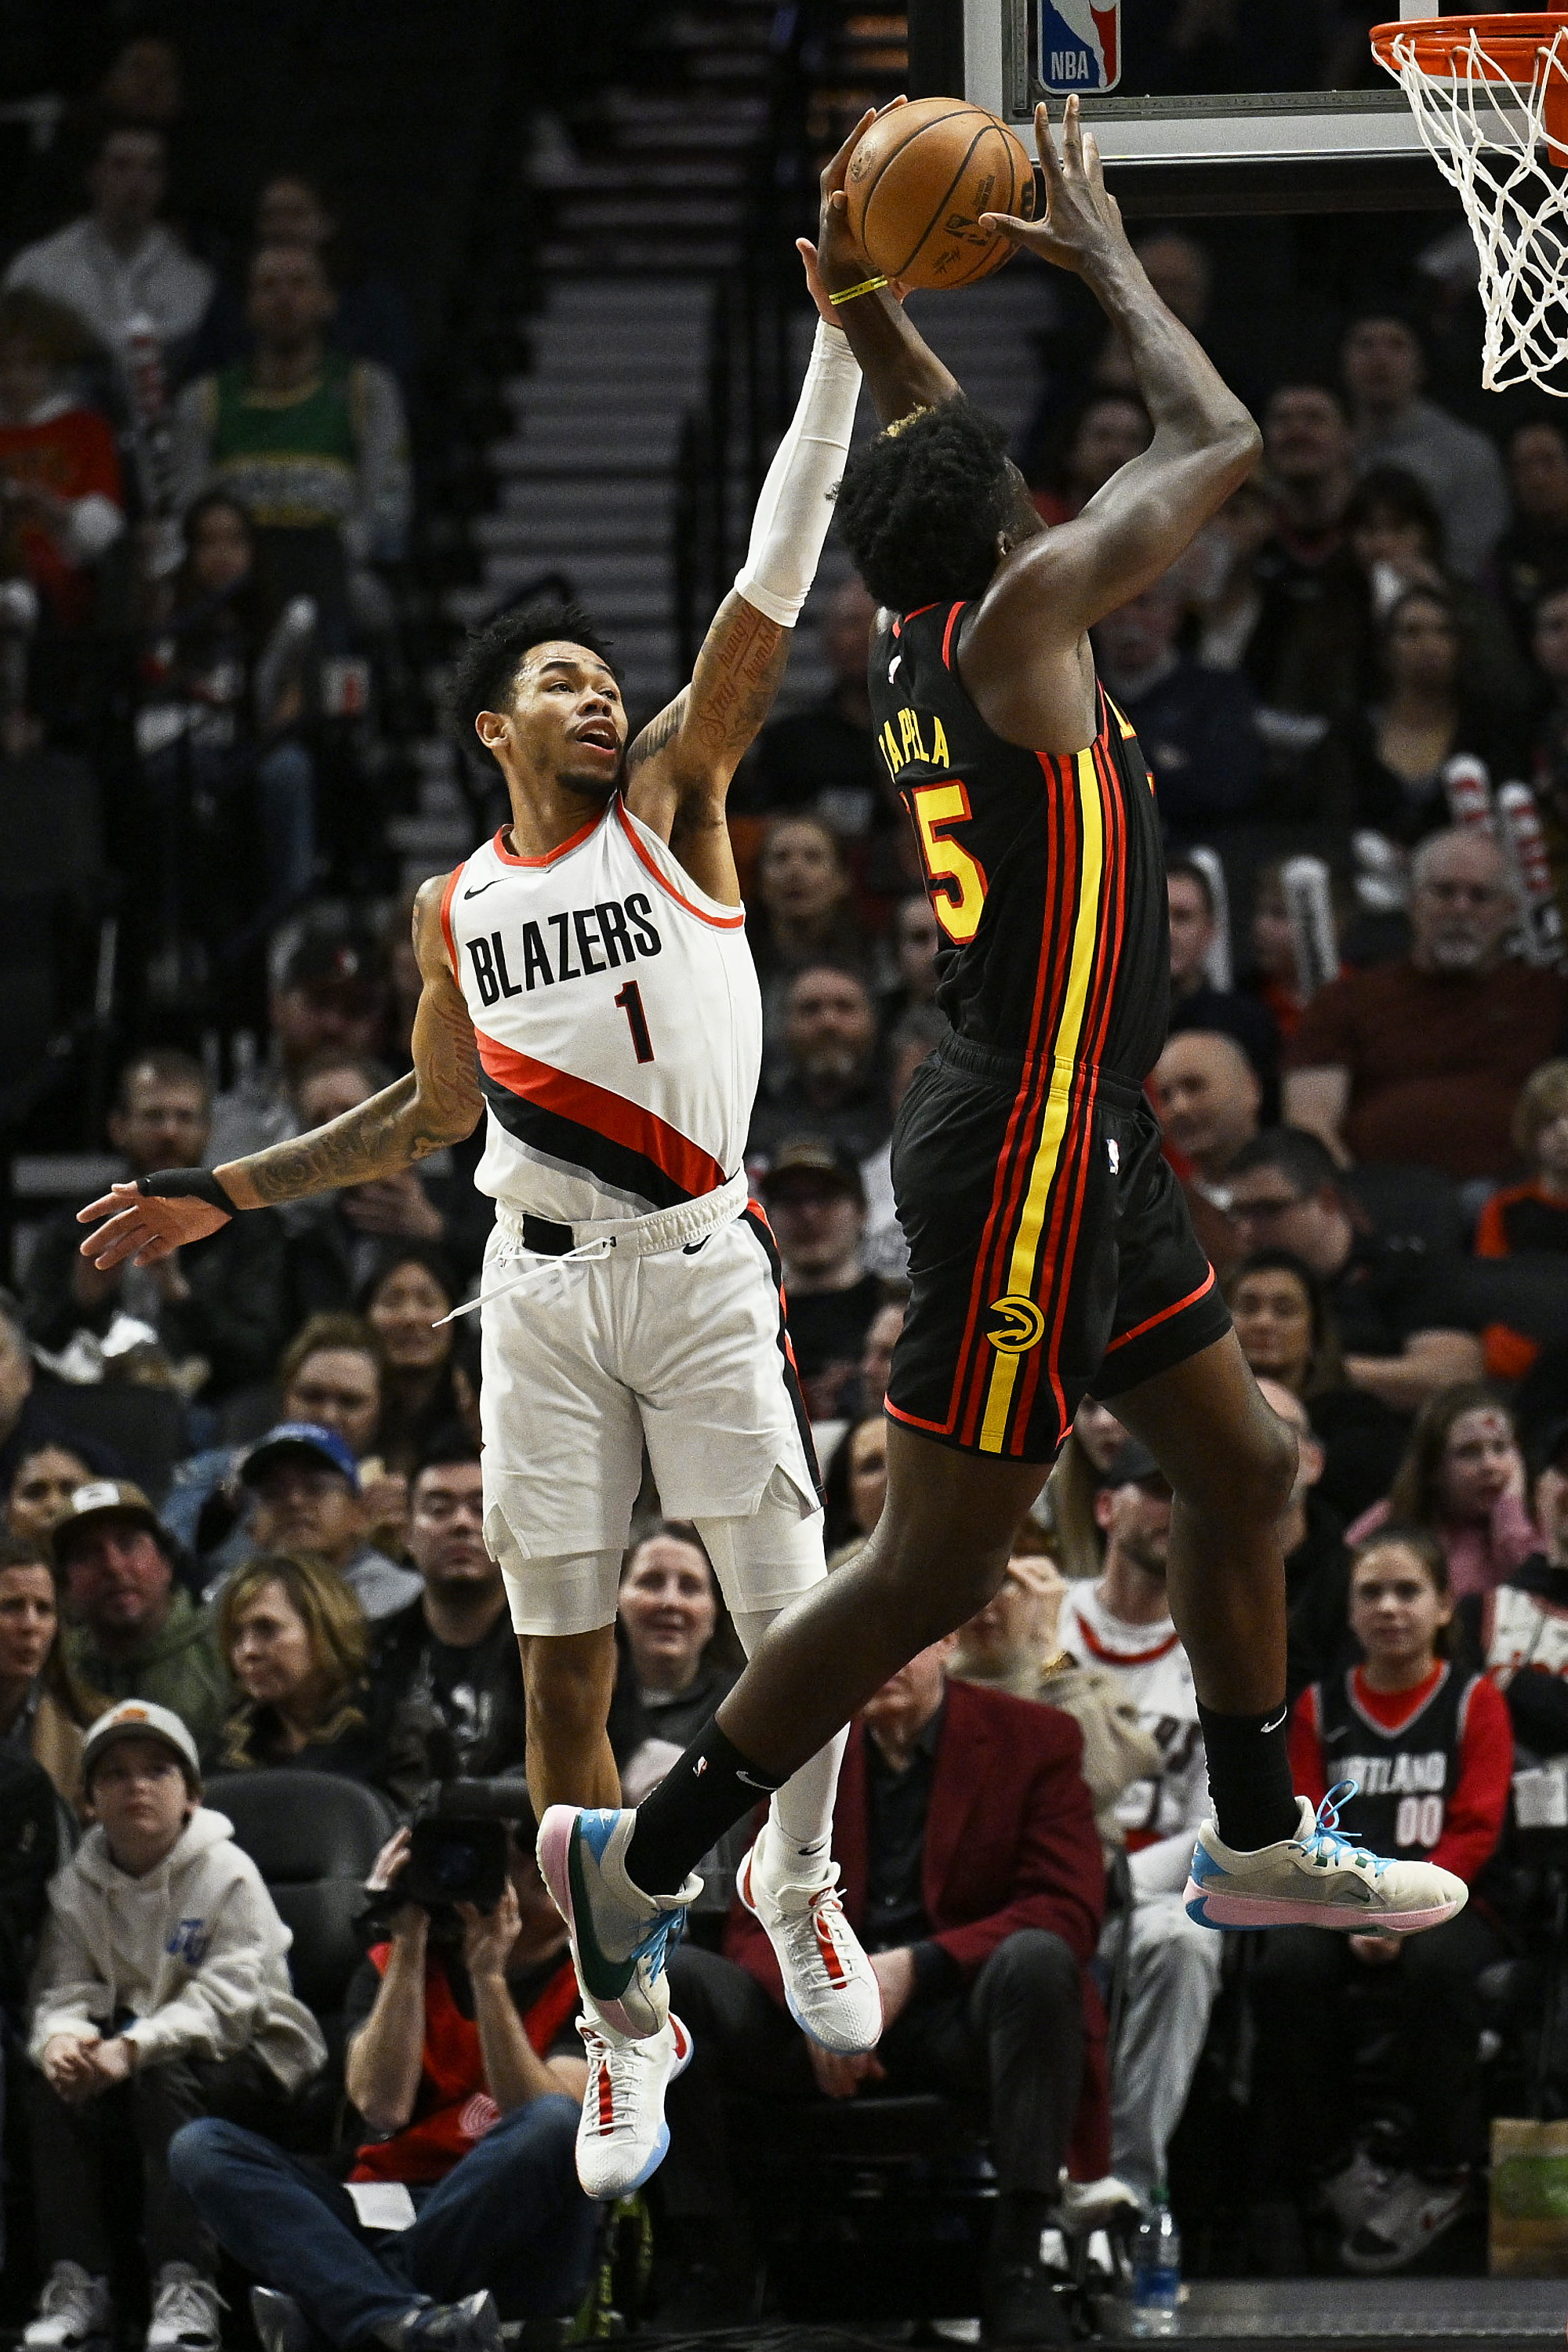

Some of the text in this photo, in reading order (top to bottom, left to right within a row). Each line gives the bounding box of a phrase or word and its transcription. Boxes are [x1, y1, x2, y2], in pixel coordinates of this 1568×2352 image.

[1051, 50, 1089, 80] NBA
[465, 892, 662, 1007] BLAZERS
[614, 979, 655, 1065] 1
[1394, 1793, 1445, 1849] 00
